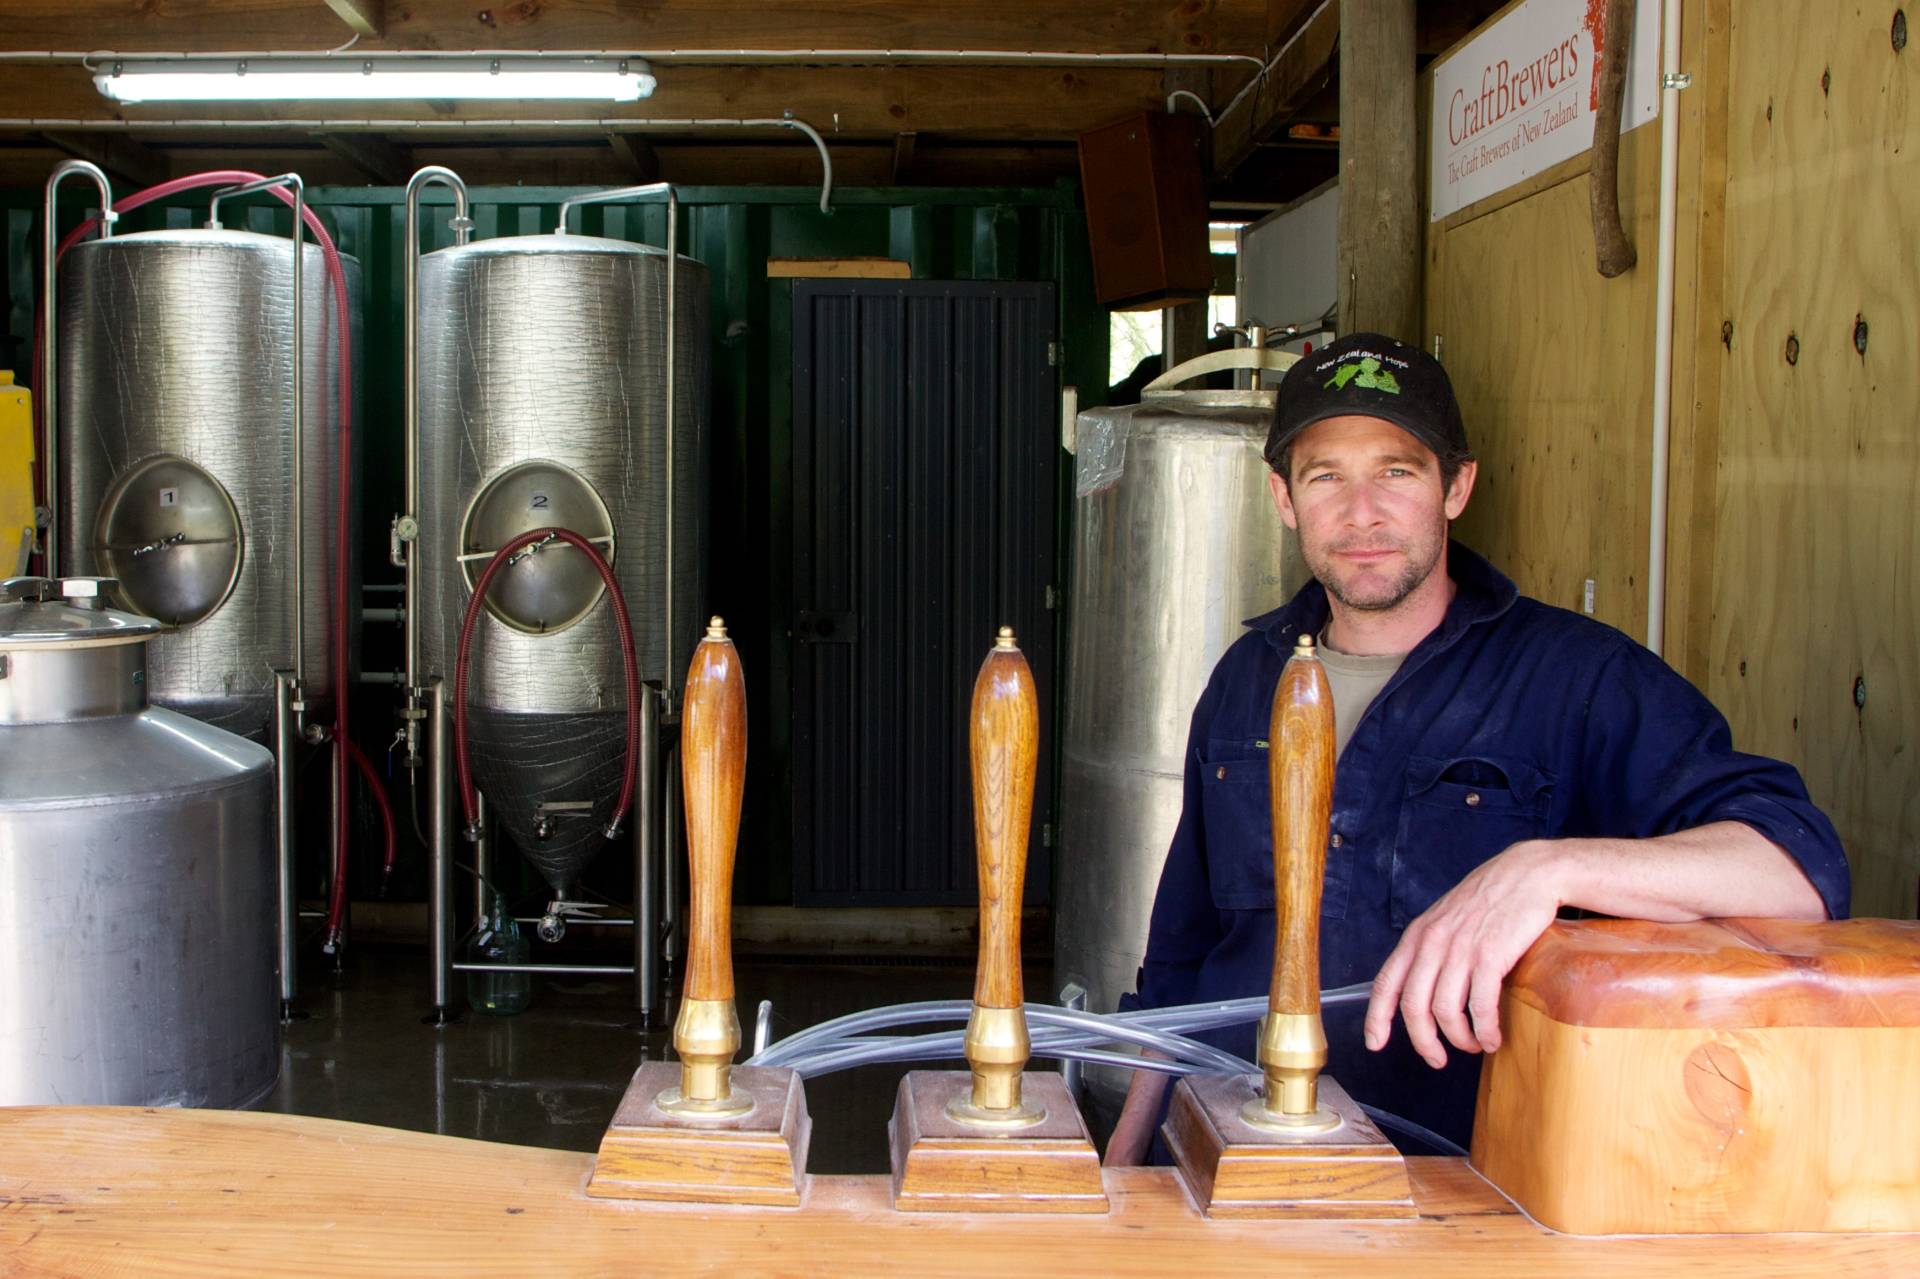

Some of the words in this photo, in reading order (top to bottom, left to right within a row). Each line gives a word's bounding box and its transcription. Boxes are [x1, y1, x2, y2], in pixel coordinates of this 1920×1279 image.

[1449, 34, 1578, 146] CraftBrewers
[1448, 161, 1460, 184] The
[1461, 147, 1479, 177] Craft
[1480, 143, 1510, 168] Brewers
[1511, 124, 1521, 152] of
[1522, 119, 1541, 147] New
[1543, 91, 1578, 135] Zealand
[163, 491, 173, 503] 1
[533, 495, 548, 507] 2
